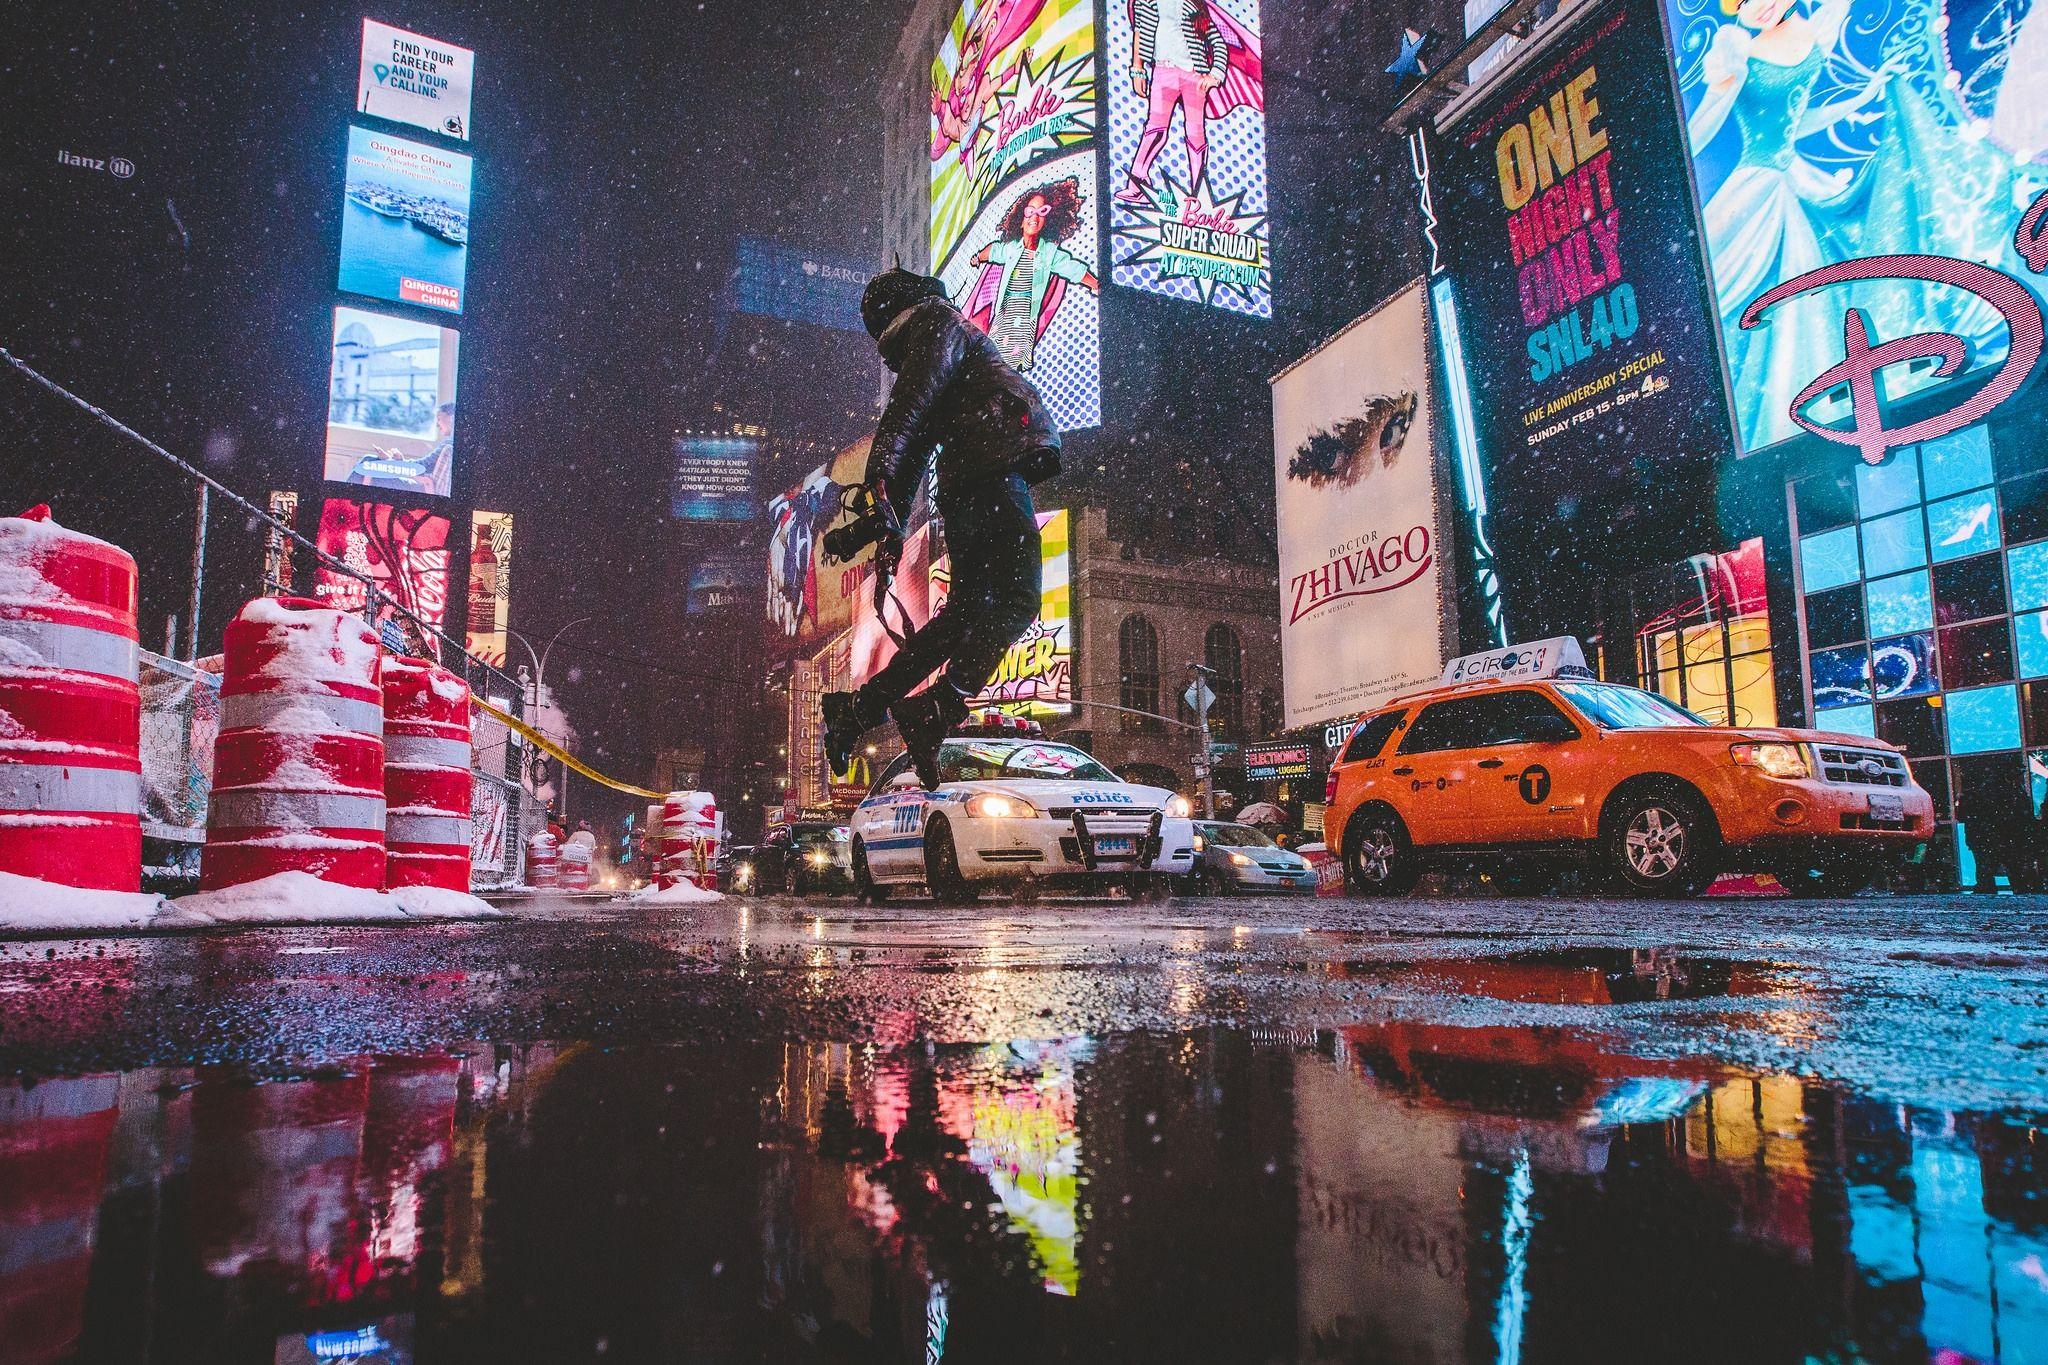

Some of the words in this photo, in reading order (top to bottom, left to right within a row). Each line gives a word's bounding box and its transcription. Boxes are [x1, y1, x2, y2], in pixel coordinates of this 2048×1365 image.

[392, 52, 437, 74] CAREER
[393, 39, 420, 56] FIND
[424, 48, 454, 66] YOUR
[390, 77, 441, 100] CALLING.
[391, 64, 414, 80] AND
[419, 71, 448, 90] YOUR
[996, 84, 1065, 151] Barbie
[1495, 64, 1610, 212] ONE
[370, 140, 418, 160] Qingdao
[421, 153, 452, 169] China
[1164, 203, 1179, 217] THE
[1182, 196, 1240, 234] Barbie
[1506, 149, 1615, 268] NIGHT
[1161, 222, 1208, 253] SUPER
[1209, 231, 1257, 261] SQUAD
[821, 264, 870, 285] BARCL
[1160, 252, 1178, 275] AT
[1177, 255, 1260, 287] BESUPER.COM
[1517, 207, 1623, 327] ONLY
[403, 279, 459, 298] QINGDAO
[421, 294, 457, 309] CHINA
[1524, 405, 1545, 426] LIVE
[1547, 371, 1617, 416] ANNIVERSARY
[1618, 349, 1666, 381] SPECIAL
[1641, 374, 1656, 393] 4
[1527, 418, 1569, 446] SUNDAY
[1571, 408, 1595, 426] FEB
[362, 460, 417, 477] SAMSUNG
[726, 459, 749, 467] KNEW
[1329, 530, 1378, 558] DOCTOR
[1289, 525, 1431, 627] ZHIVAGO
[1328, 600, 1355, 614] MUSICAL
[986, 636, 1057, 690] WER
[1359, 679, 1383, 690] Broadway
[1325, 723, 1356, 748] GIF
[1248, 748, 1307, 766] ELECTRONICS
[1250, 767, 1276, 777] CAMERA
[1278, 764, 1307, 775] LUGGAGE
[1071, 794, 1133, 804] POLICE
[892, 804, 921, 834] NYPD
